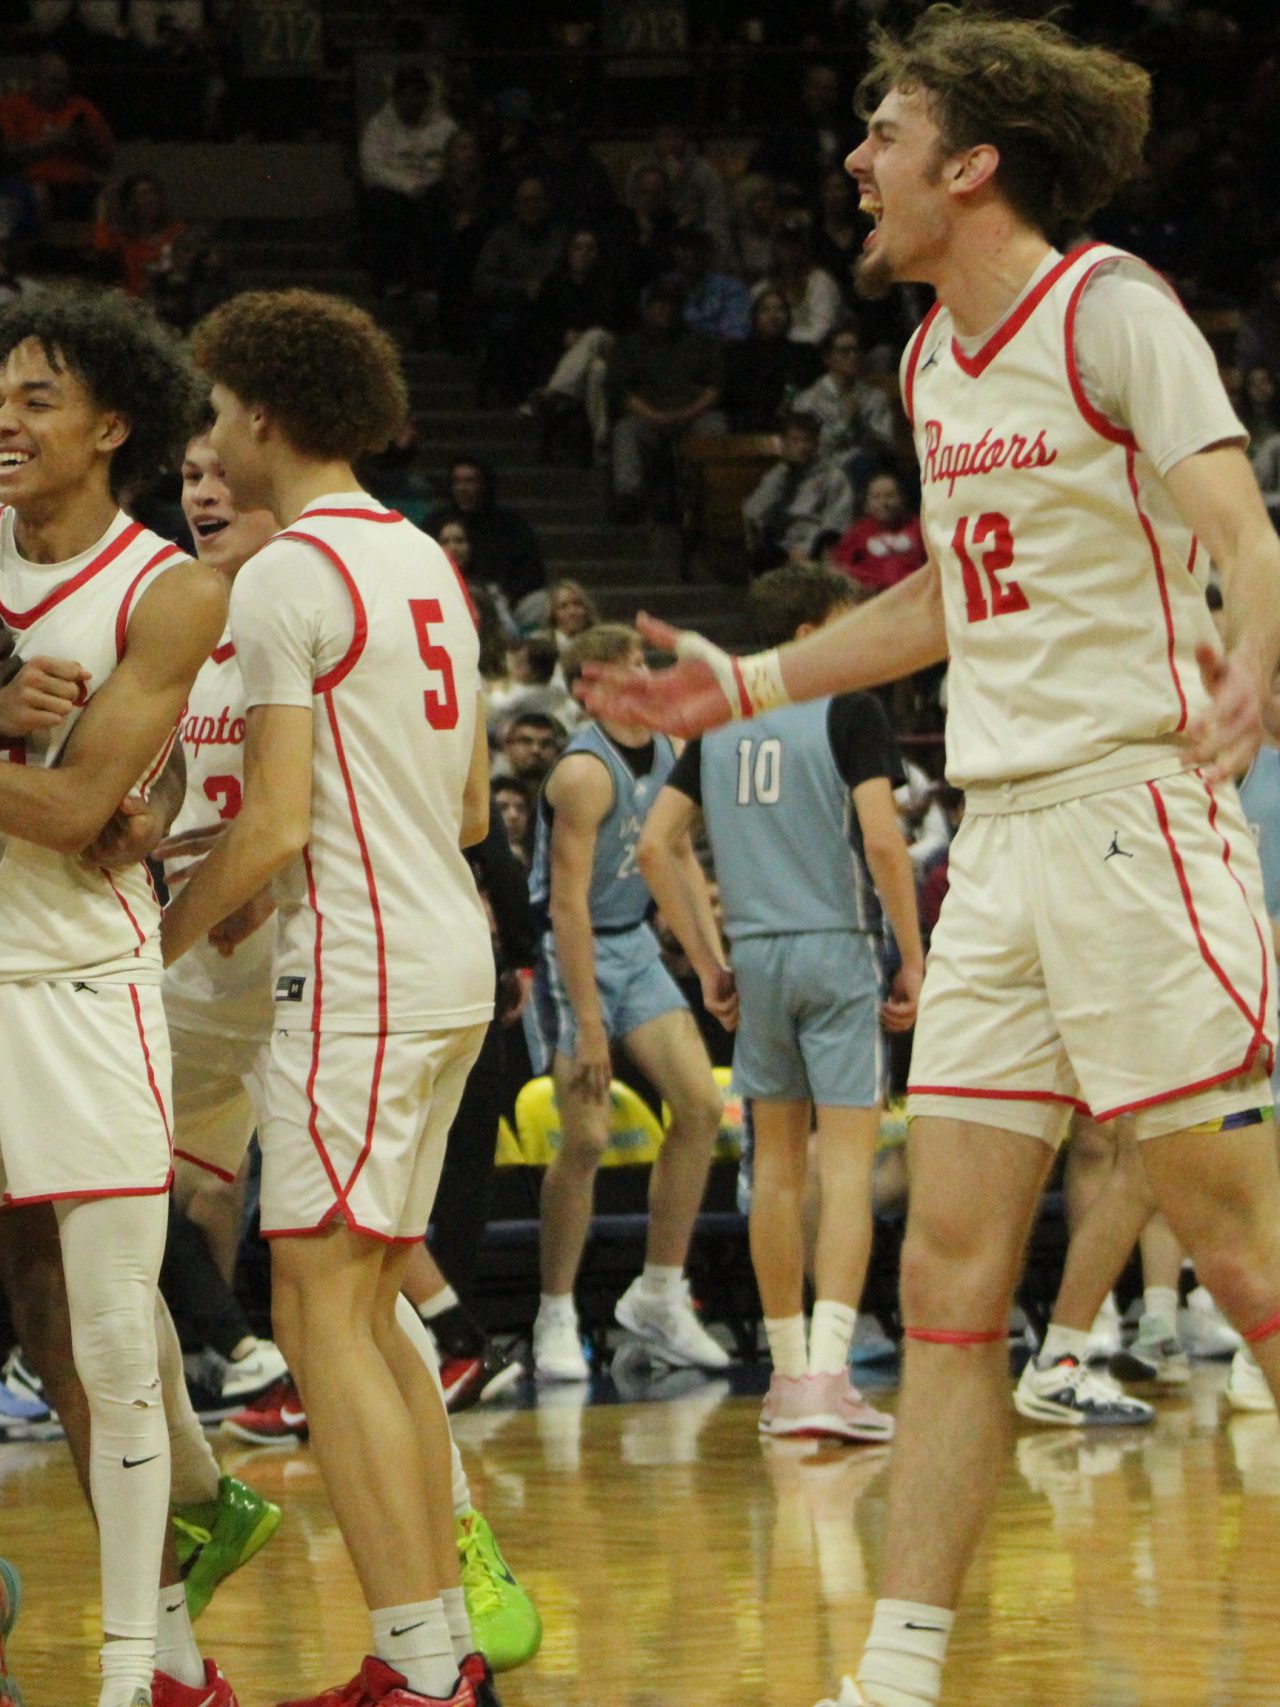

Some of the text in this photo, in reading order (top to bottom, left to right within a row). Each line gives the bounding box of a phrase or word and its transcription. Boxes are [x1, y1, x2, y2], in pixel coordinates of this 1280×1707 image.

[257, 11, 322, 62] 212
[923, 420, 1057, 498] Raptors
[951, 512, 1030, 623] 12
[408, 599, 459, 730] 5
[737, 739, 781, 805] 10
